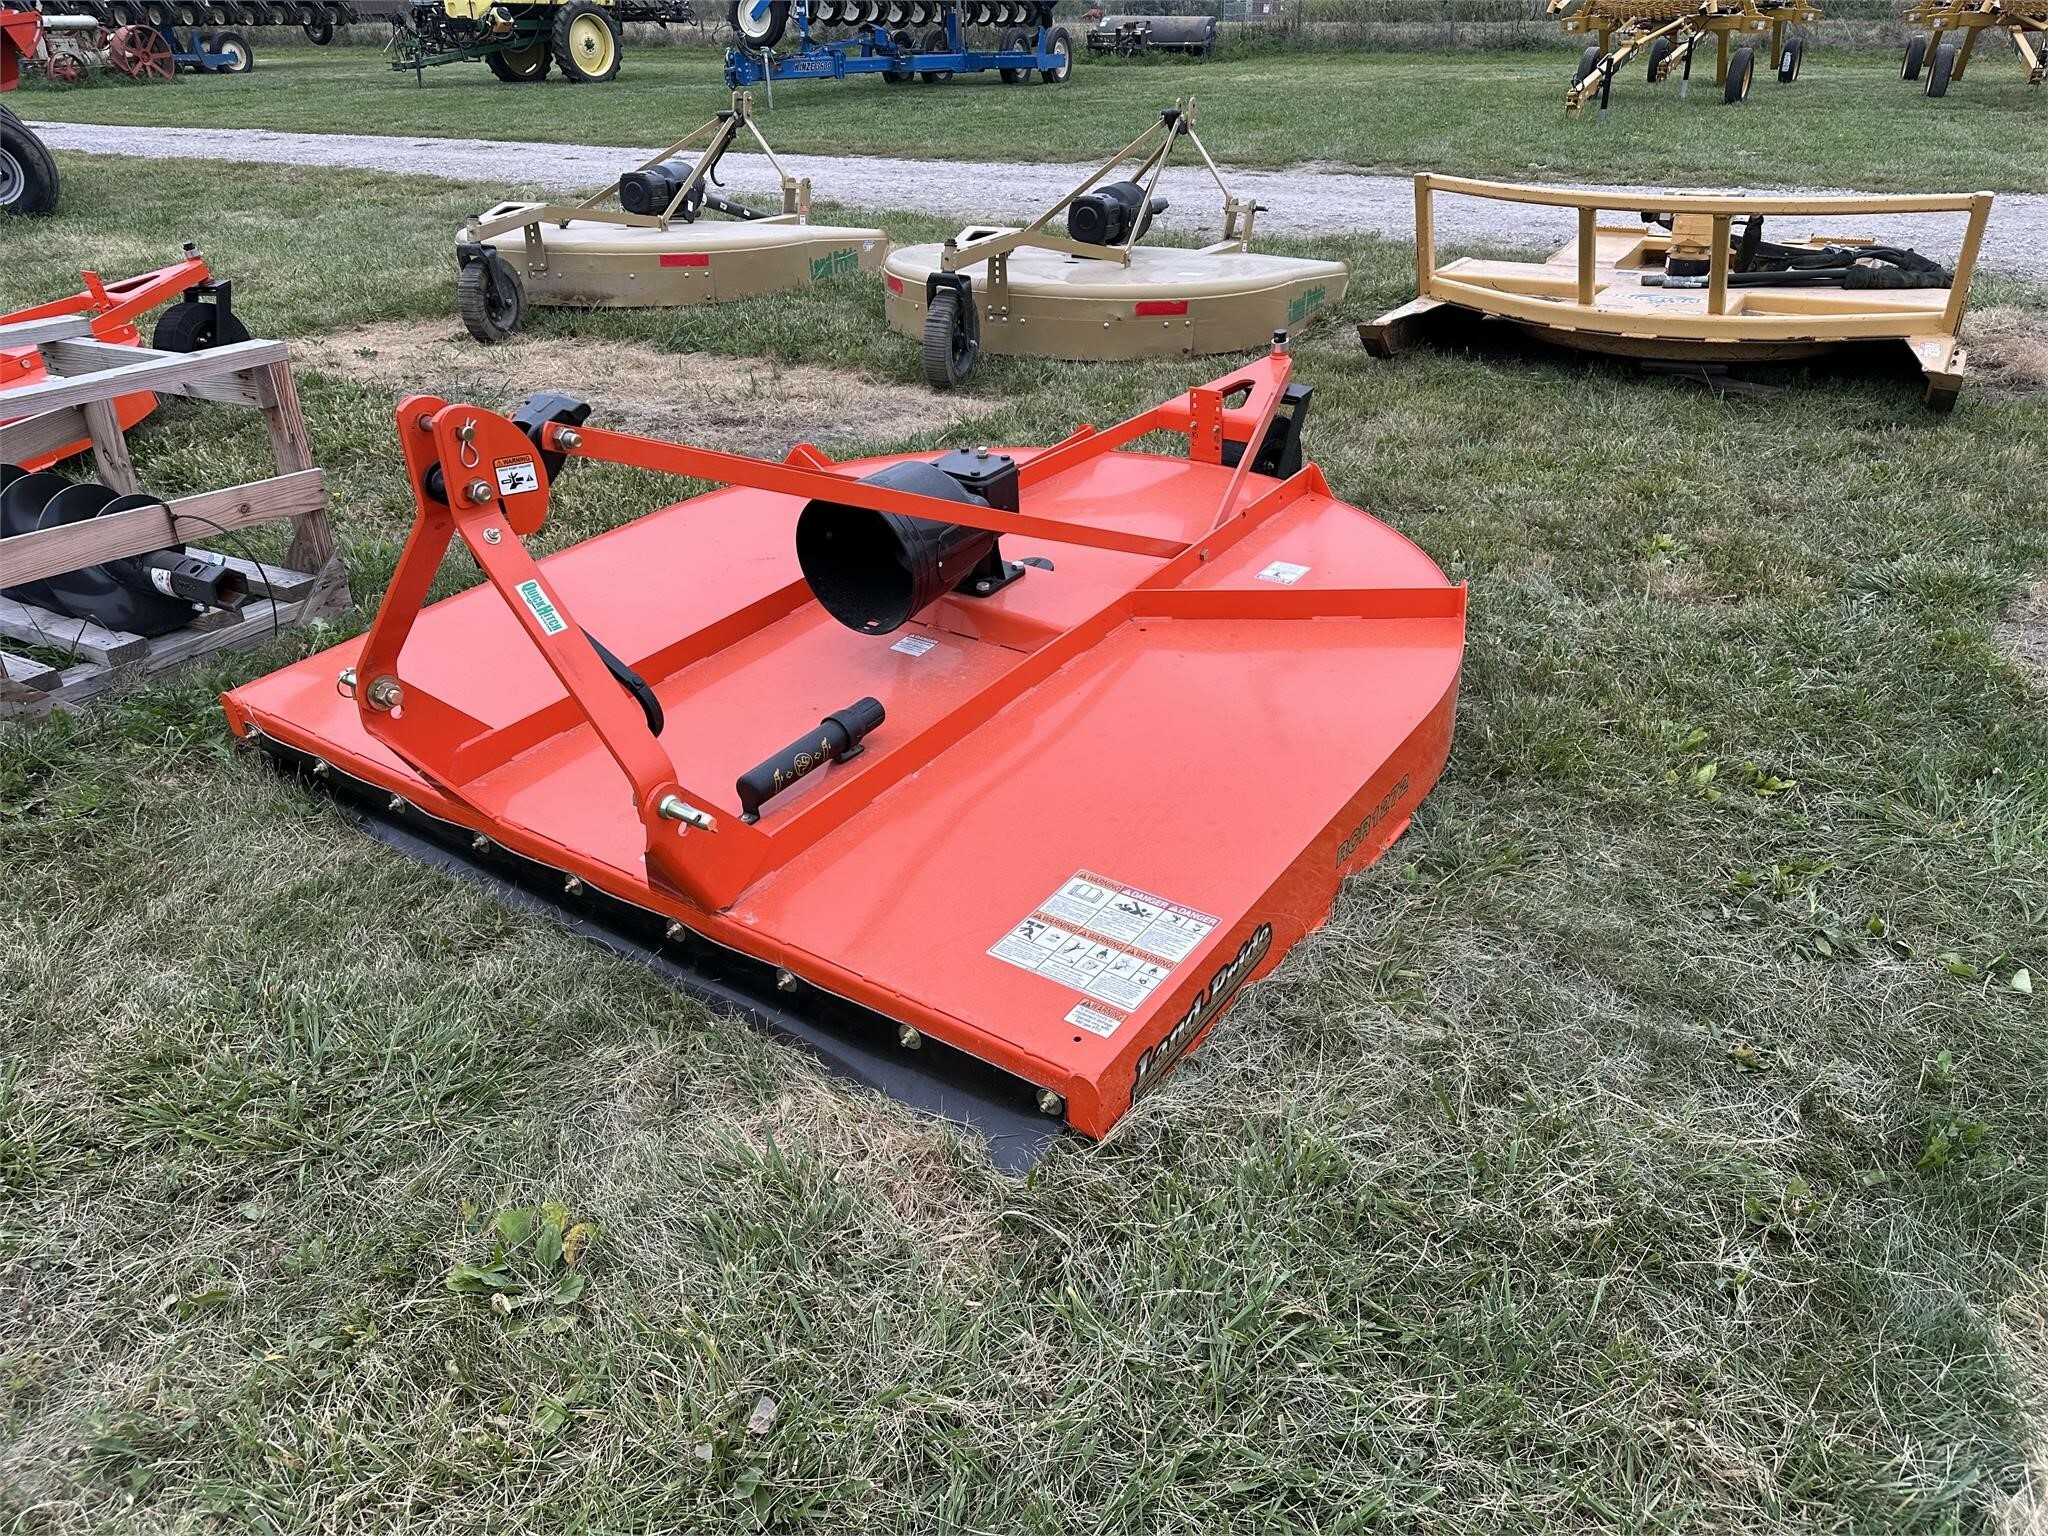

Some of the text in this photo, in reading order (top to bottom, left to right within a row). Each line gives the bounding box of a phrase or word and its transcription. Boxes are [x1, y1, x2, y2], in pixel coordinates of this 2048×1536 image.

[794, 61, 815, 72] KINZE
[503, 456, 530, 465] WARNING
[1086, 875, 1122, 892] WARNING
[1131, 891, 1169, 910] DANGER
[1042, 915, 1078, 934] WARNING
[1177, 908, 1220, 927] DANGER
[1087, 931, 1126, 951] WARNING
[1135, 950, 1176, 969] WARNING
[1091, 1002, 1125, 1021] WARNING
[1136, 988, 1205, 1088] Land
[1208, 922, 1272, 1002] Pride
